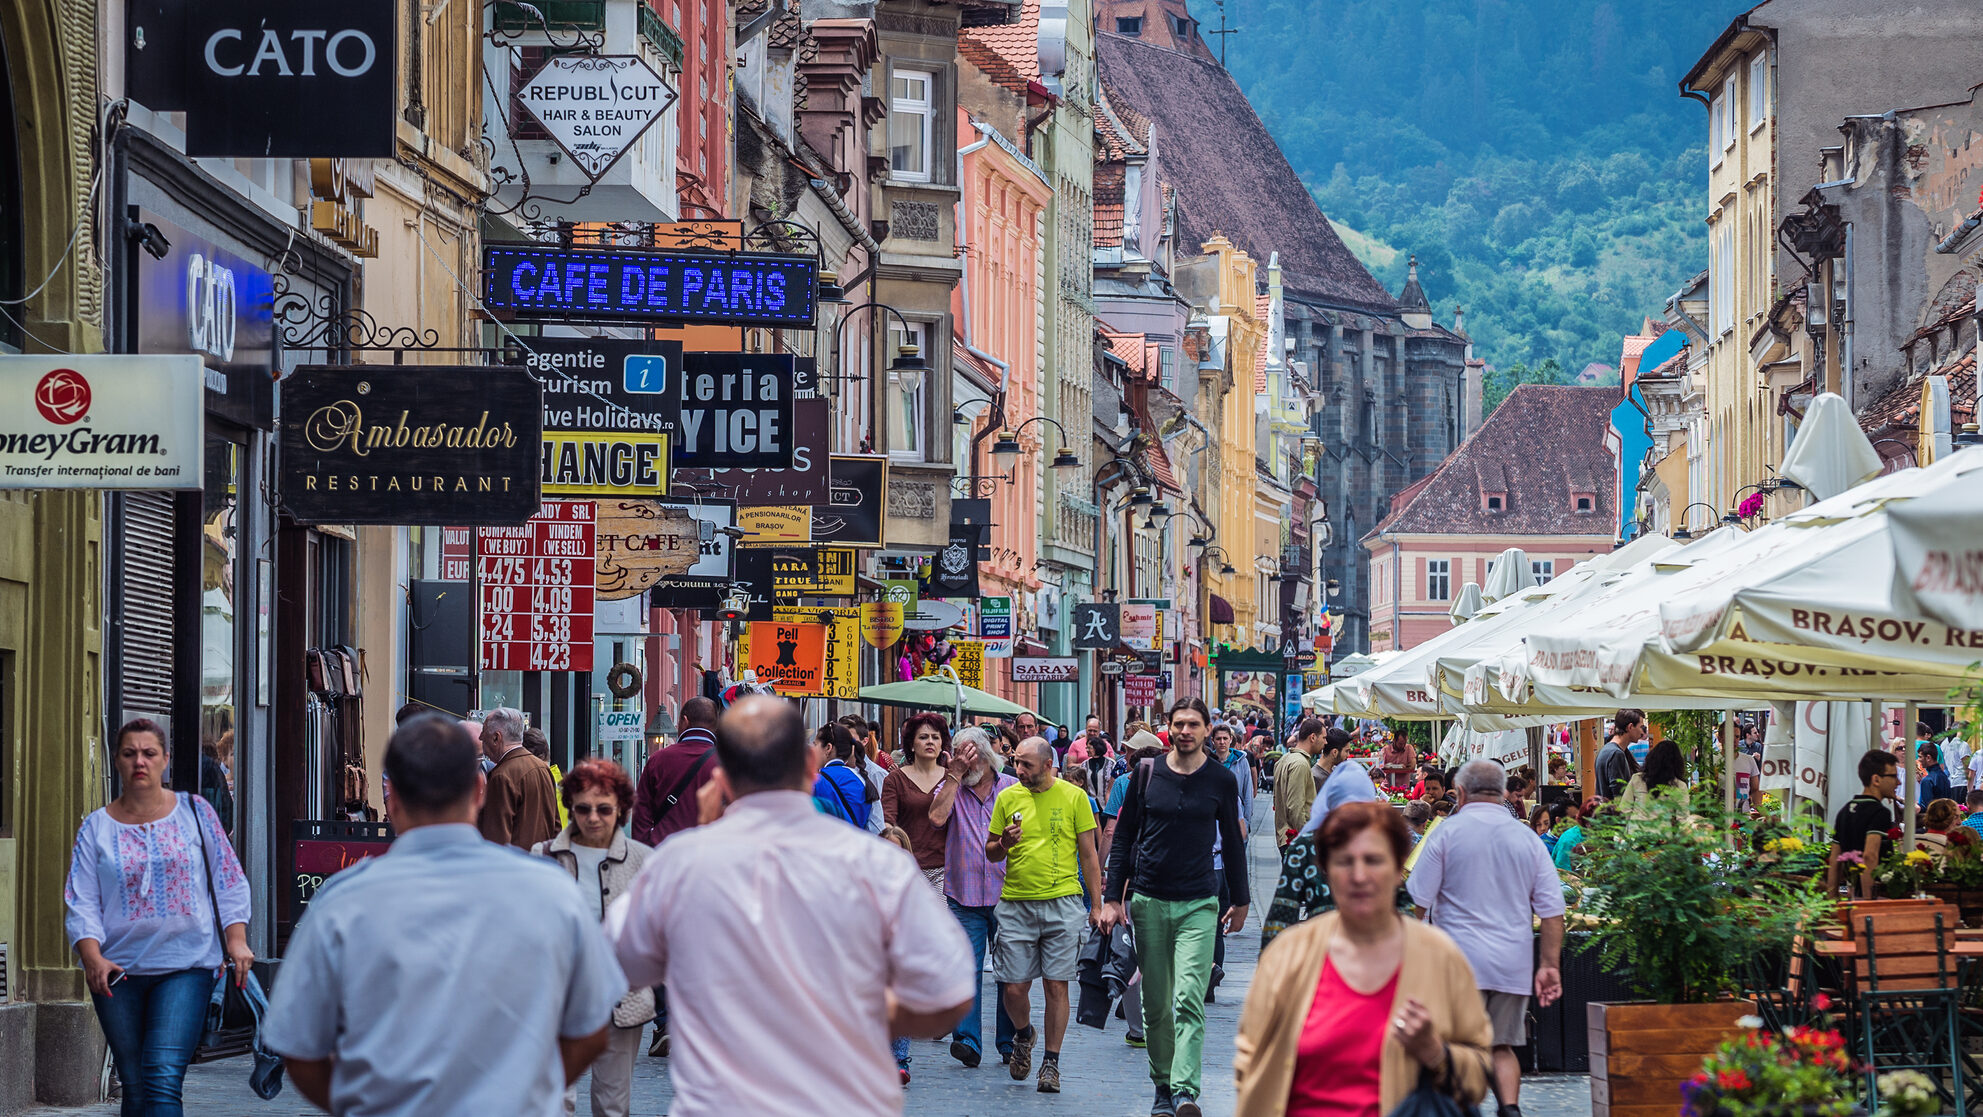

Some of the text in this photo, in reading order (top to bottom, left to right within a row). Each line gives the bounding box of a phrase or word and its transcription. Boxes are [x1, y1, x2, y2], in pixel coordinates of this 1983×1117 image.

[203, 28, 376, 77] CATO
[543, 109, 652, 121] HAIR & BEAUTY
[573, 125, 621, 136] SALON
[511, 261, 785, 311] CAFE DE PARIS
[187, 253, 236, 363] CATO
[526, 350, 605, 371] agentie
[541, 375, 612, 395] turism
[305, 400, 517, 457] Ambasador
[714, 409, 780, 454] ICE
[5, 465, 53, 477] Transfer
[136, 465, 151, 476] de
[154, 465, 181, 476] bani
[306, 476, 511, 492] RESTAURANT
[767, 484, 812, 498] shop
[572, 505, 590, 519] SRL
[745, 511, 802, 523] PENSIONARILOR
[479, 526, 533, 538] COMPARAM
[549, 525, 583, 539] VINDEM
[624, 534, 681, 551] CAFE
[477, 557, 572, 585] 4,475 4,53
[484, 586, 572, 613] ,00 4,09
[808, 607, 859, 617] VICORIA
[533, 615, 571, 642] 5,38
[777, 627, 798, 640] Pell
[1792, 608, 1930, 645] BRAȘOV.
[482, 643, 570, 670] ,11 4,23
[756, 664, 814, 680] Collection
[1016, 665, 1074, 674] SARAY
[607, 713, 641, 726] OPEN
